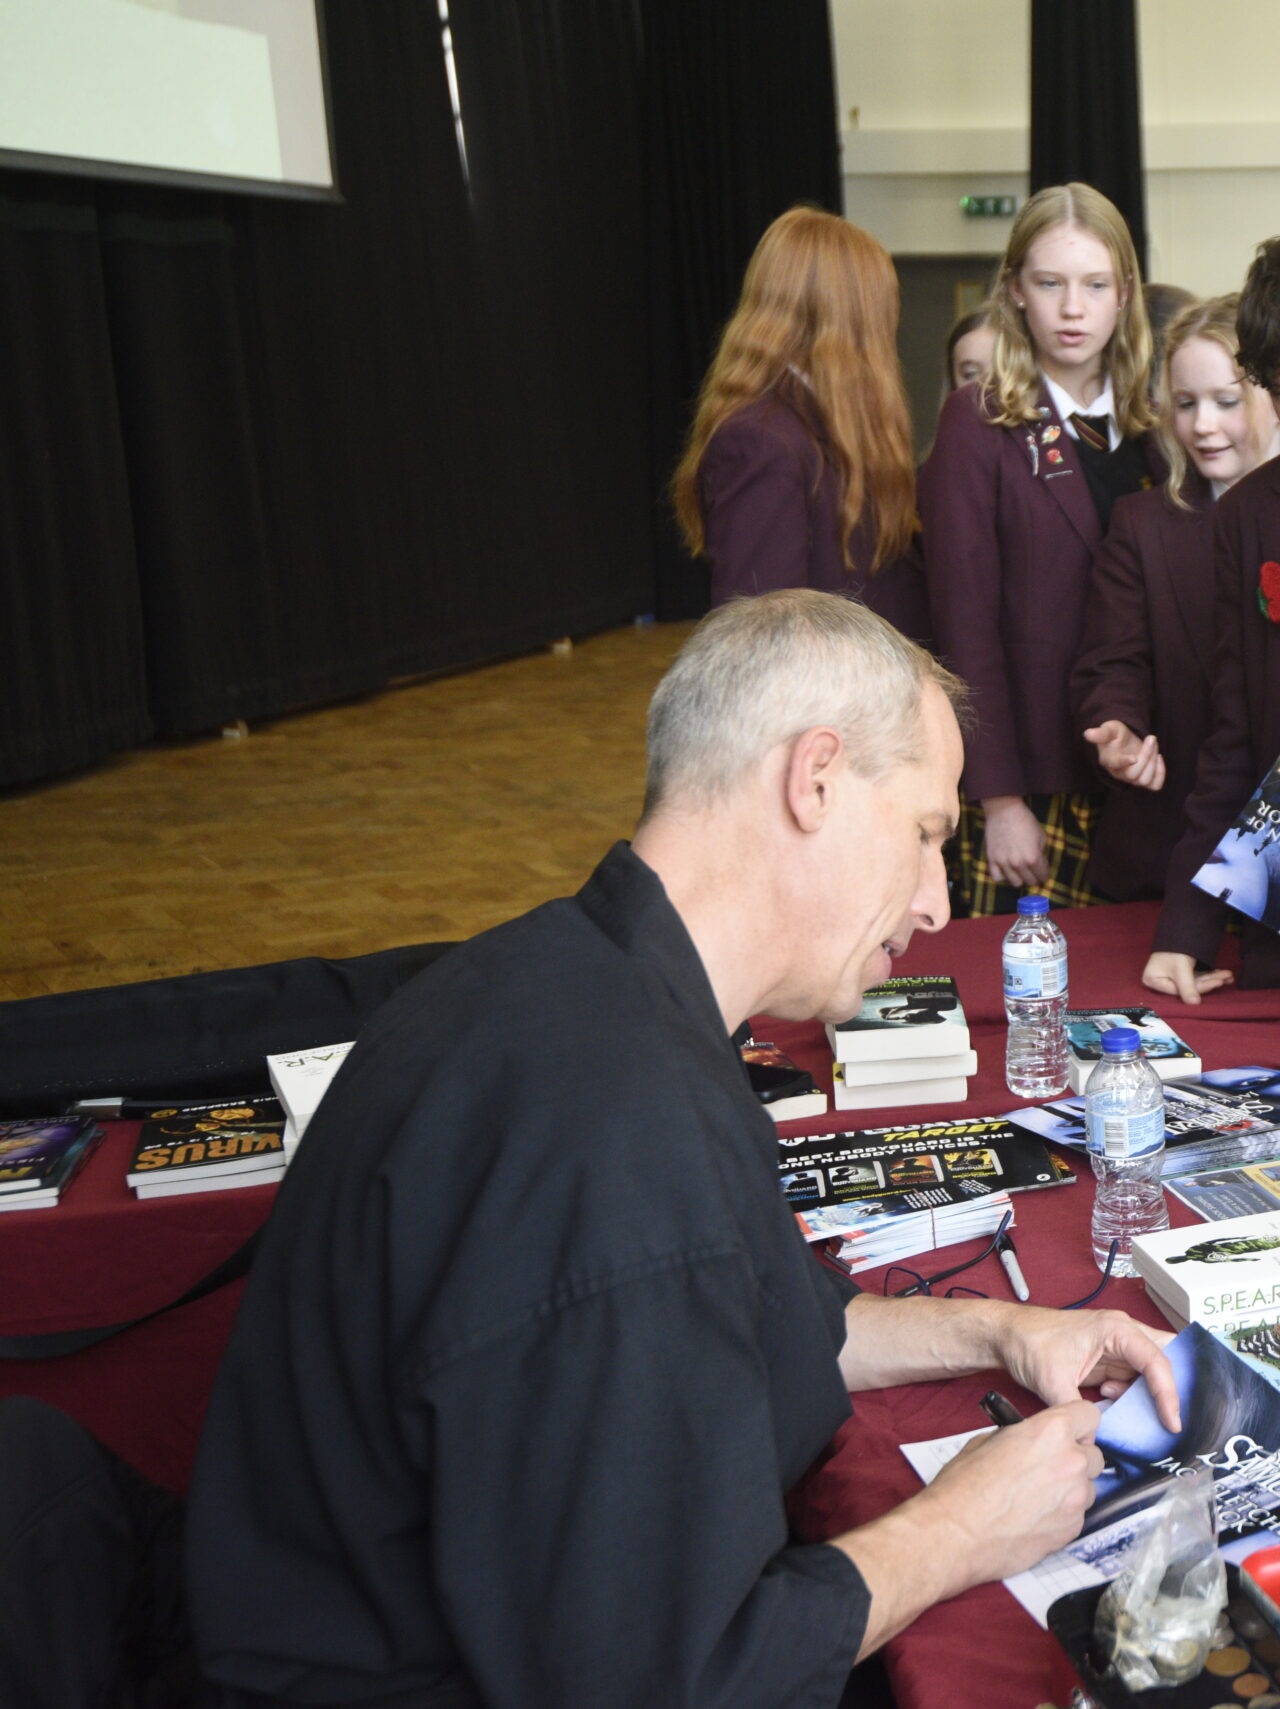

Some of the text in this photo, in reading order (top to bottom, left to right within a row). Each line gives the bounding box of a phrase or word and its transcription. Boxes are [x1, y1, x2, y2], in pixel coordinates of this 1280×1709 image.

[1247, 815, 1266, 831] OF
[883, 1121, 1010, 1142] TARGET
[134, 1133, 282, 1170] VIRUS
[778, 1140, 987, 1170] ONE NOBODY NOTICES.
[786, 1152, 835, 1164] BEST
[840, 1138, 951, 1156] BODYGUARD
[979, 1132, 1015, 1140] THE
[1152, 1457, 1197, 1479] JAC
